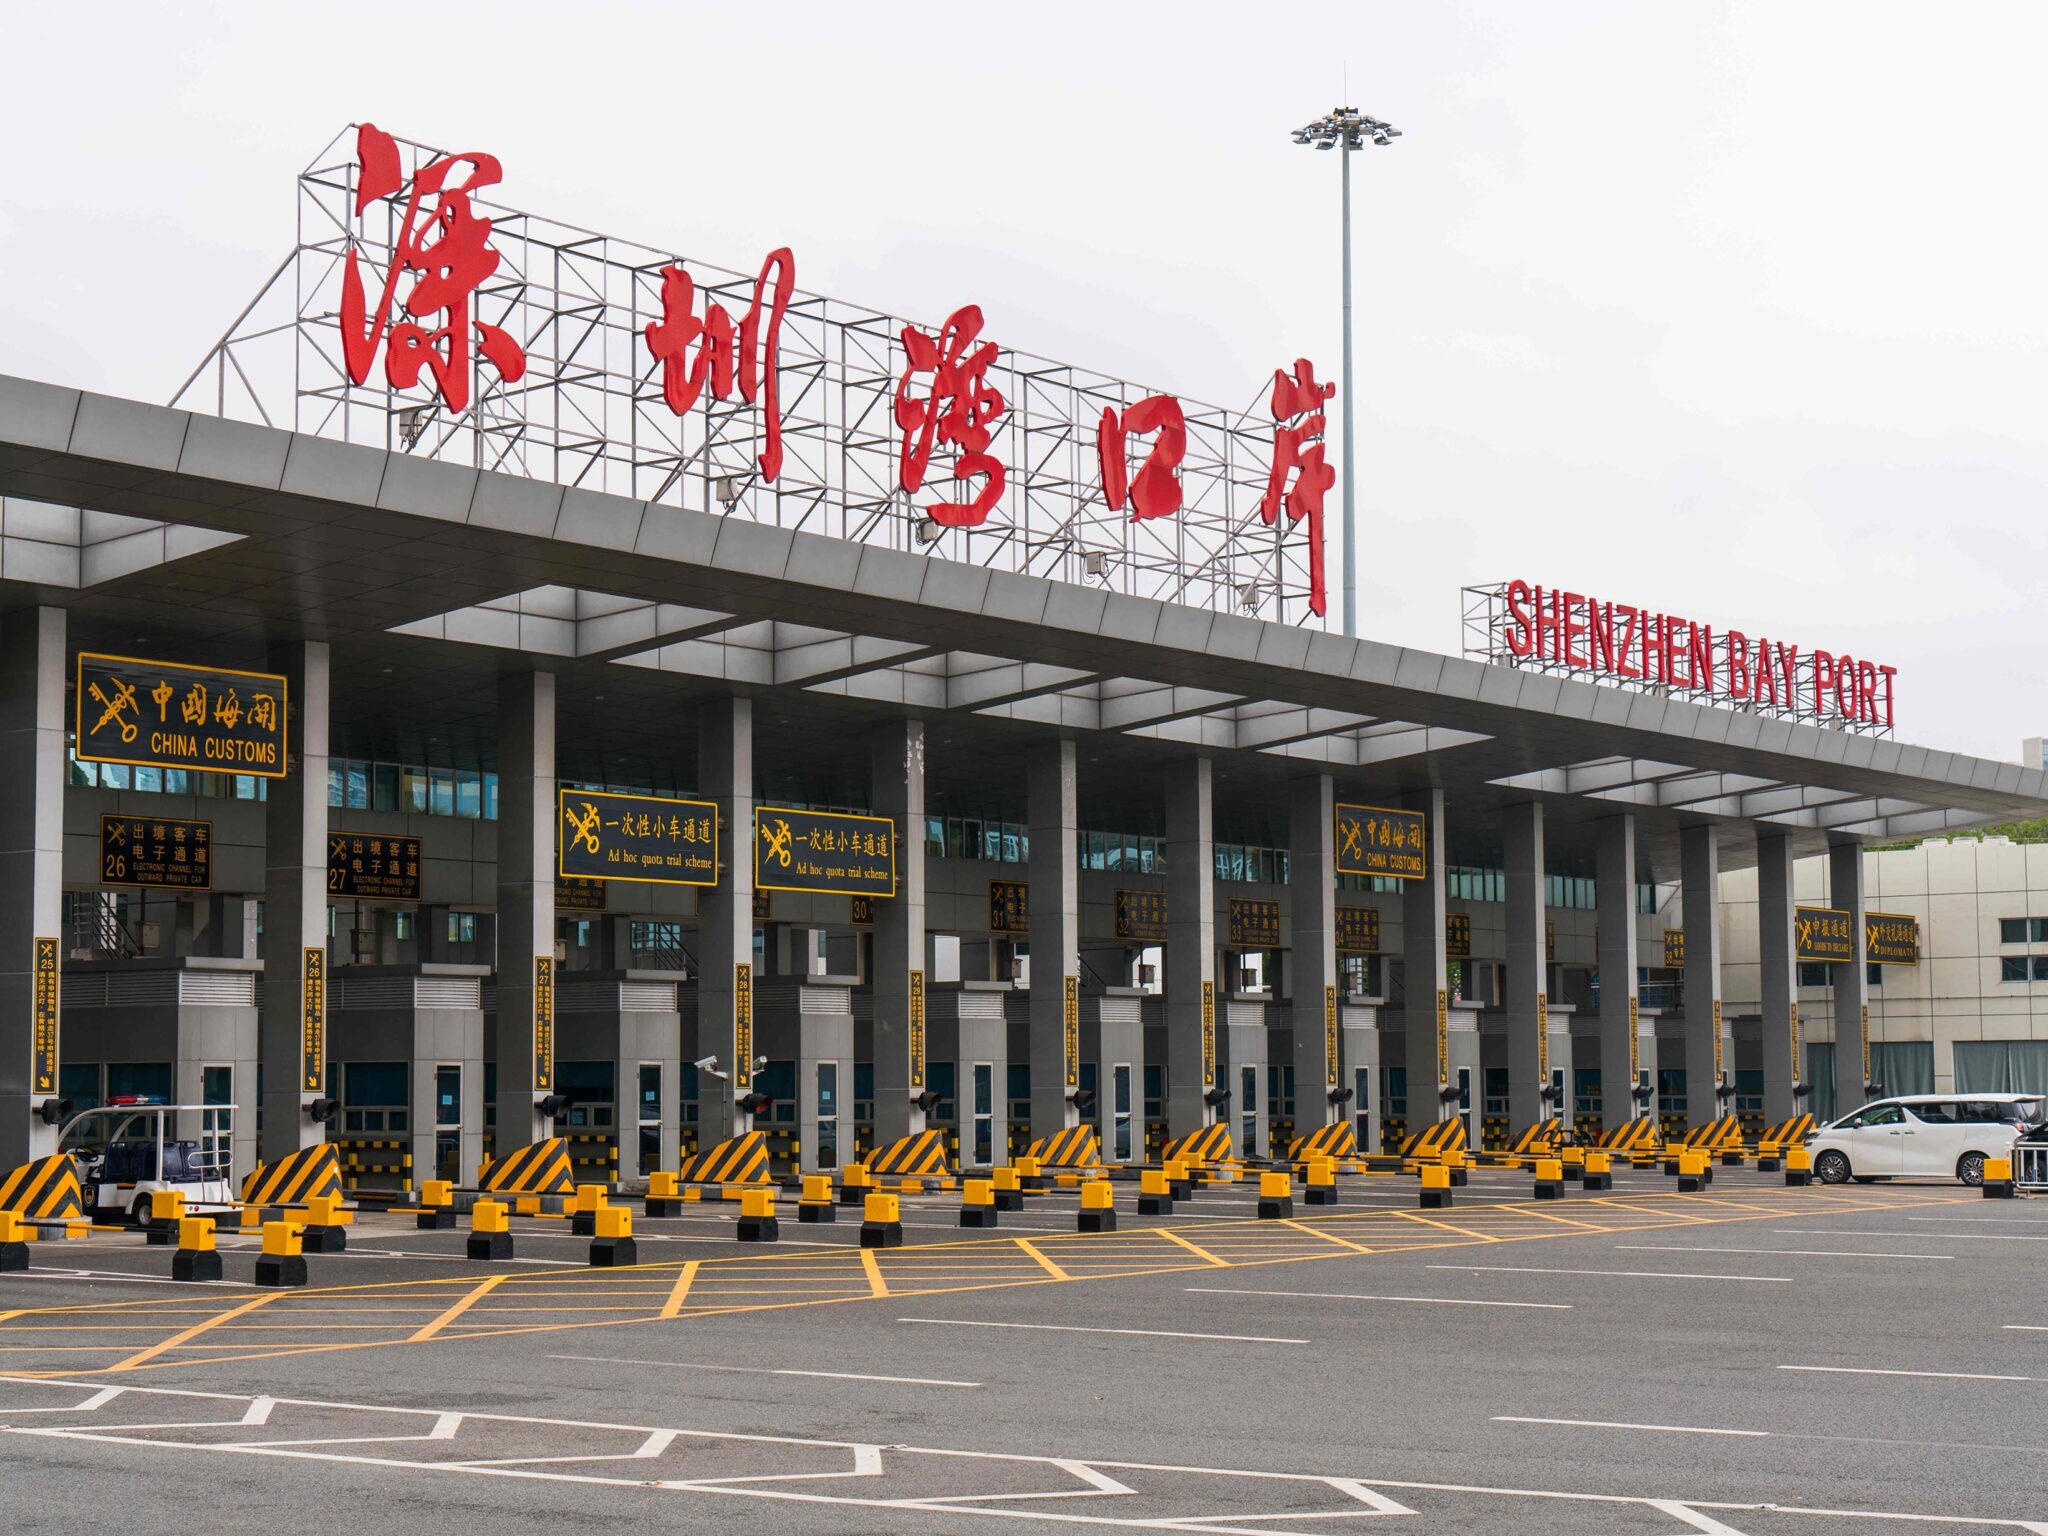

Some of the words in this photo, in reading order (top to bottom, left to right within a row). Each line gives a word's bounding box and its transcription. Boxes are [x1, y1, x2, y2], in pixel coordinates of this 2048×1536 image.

[1505, 579, 1713, 692] SHENZHEN
[1728, 630, 1798, 709] BAY
[1813, 649, 1898, 728] PORT
[151, 732, 198, 757] CHINA
[205, 737, 276, 764] CUSTOMS
[133, 823, 207, 843] 出境客车
[605, 812, 712, 843] 一次性小车通道
[353, 839, 418, 858] 出境客车
[795, 827, 889, 857] 一次性小车通道
[132, 844, 207, 863] 电子通道
[608, 849, 620, 862] Ad
[623, 850, 638, 863] hoc
[641, 852, 664, 868] quota
[666, 853, 682, 866] trial
[685, 854, 712, 869] scheme
[1367, 852, 1387, 867] CHINA
[1390, 854, 1421, 871] CUSTOMS
[106, 854, 126, 878] 26
[352, 858, 418, 877] 电子通道
[796, 862, 807, 875] Ad
[810, 862, 823, 876] hoc
[825, 867, 845, 880] quota
[848, 865, 862, 878] trial
[864, 866, 889, 880] scheme
[329, 868, 347, 890] 27
[854, 901, 867, 919] 30
[992, 910, 1004, 927] 31
[1118, 917, 1129, 934] 32
[1880, 945, 1914, 957] DIPLOMATS
[41, 959, 54, 969] 25
[309, 967, 320, 977] 26
[539, 975, 549, 984] 27
[739, 980, 748, 989] 28
